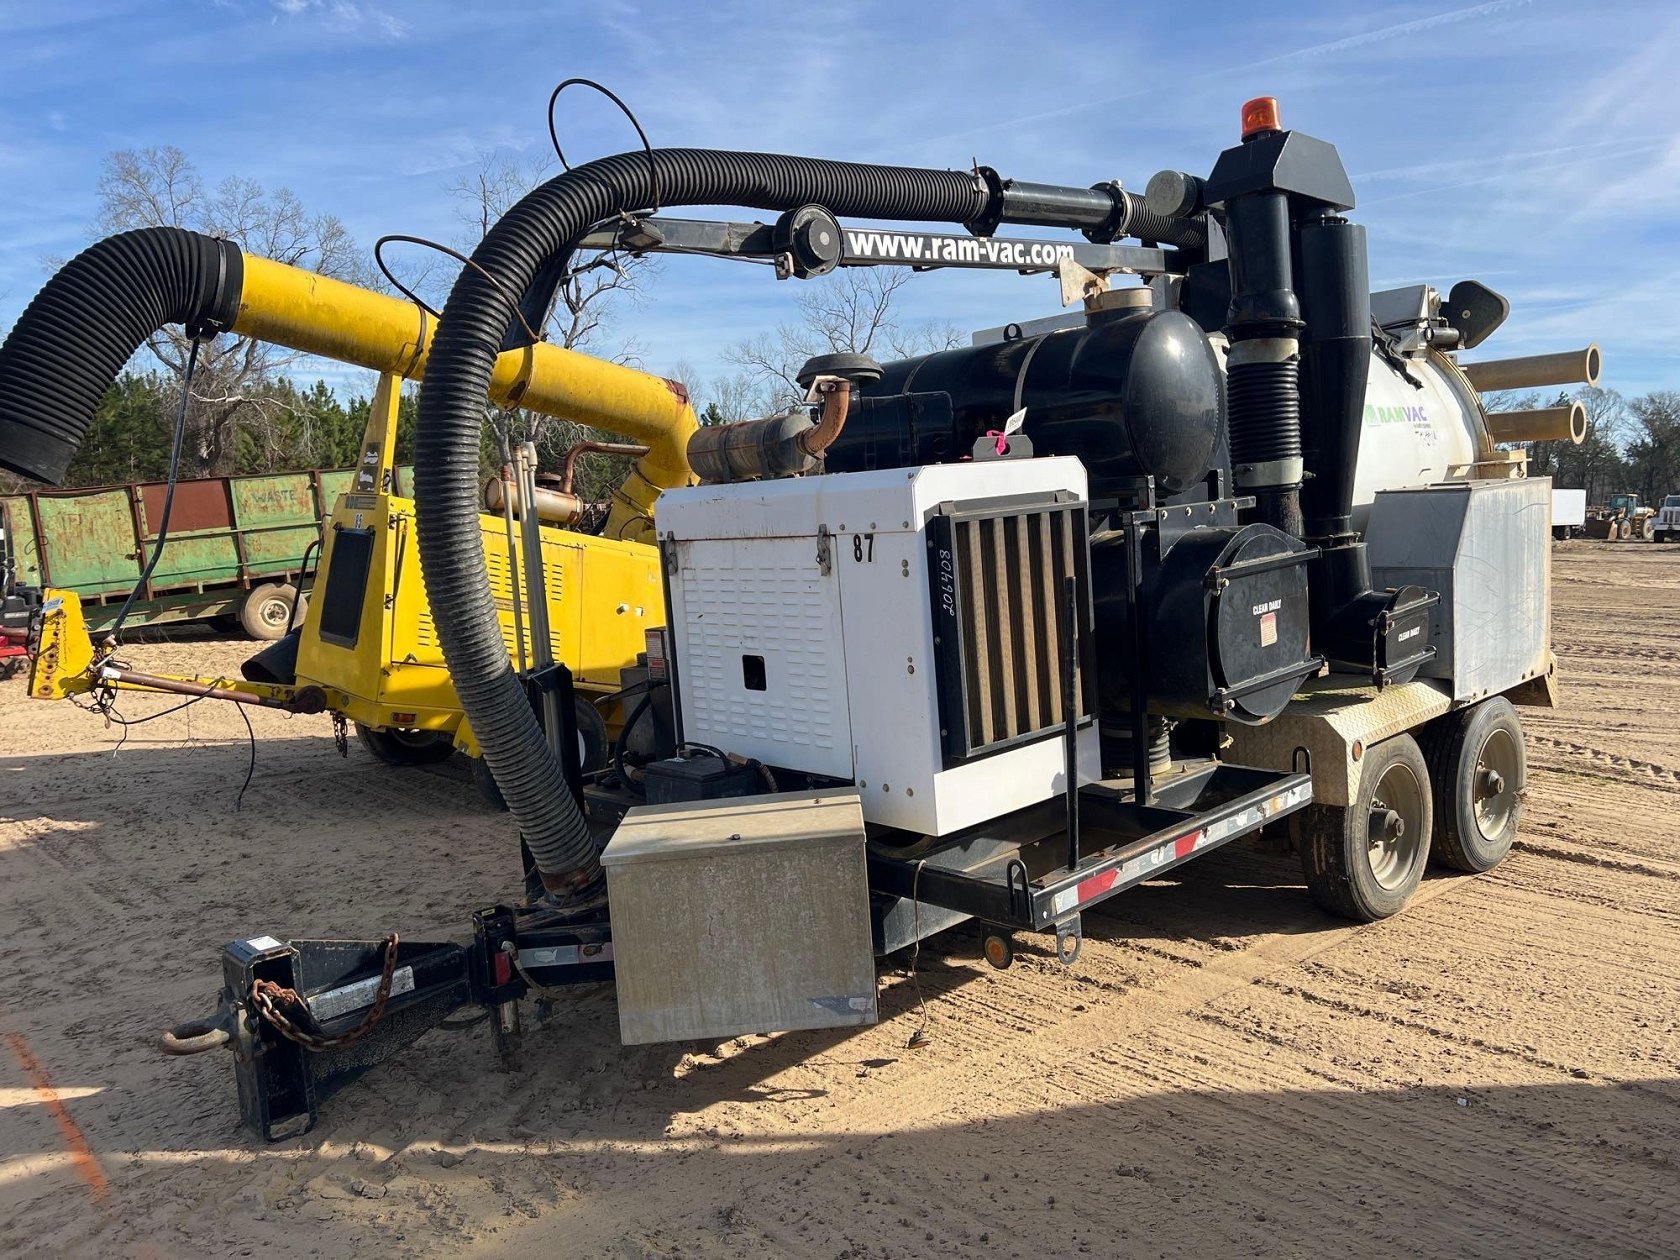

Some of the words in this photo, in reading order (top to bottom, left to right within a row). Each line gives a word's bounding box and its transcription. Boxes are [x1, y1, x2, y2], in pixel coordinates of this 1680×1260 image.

[848, 232, 1075, 265] www.ram-vac.com
[251, 489, 297, 503] WASTE
[853, 534, 874, 563] 87
[939, 549, 955, 617] 206408
